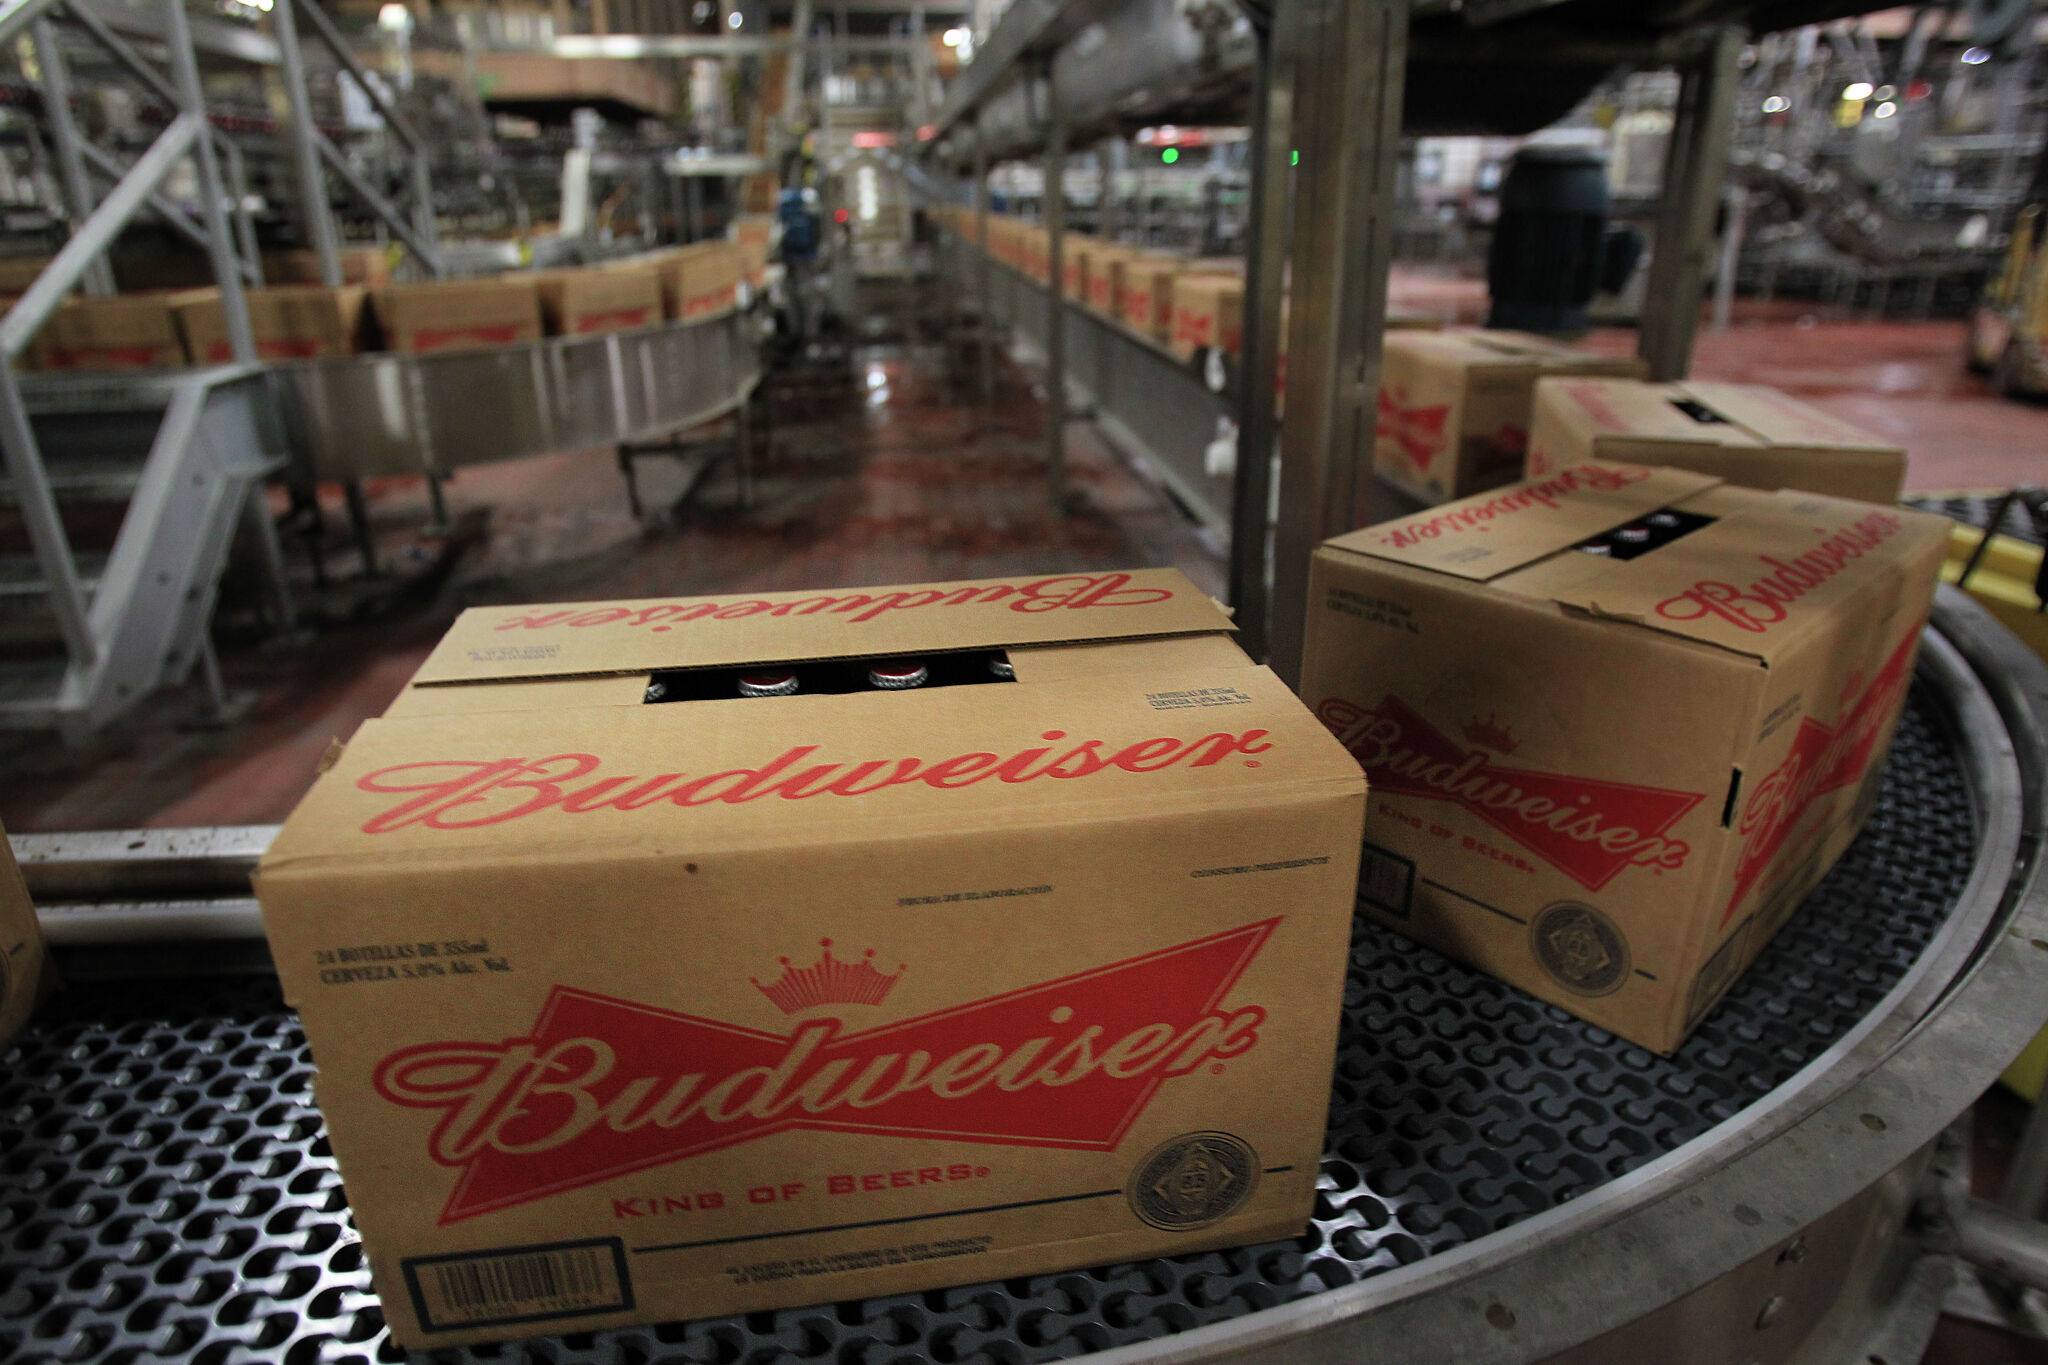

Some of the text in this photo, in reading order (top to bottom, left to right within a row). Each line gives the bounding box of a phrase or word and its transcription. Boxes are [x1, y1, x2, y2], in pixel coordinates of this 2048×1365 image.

[494, 572, 1174, 633] Budweiser
[355, 728, 1272, 834] Budweiser
[1319, 698, 1690, 878] Budweiser
[374, 1004, 1268, 1166] Budweiser
[613, 1164, 974, 1219] KING OF BEERS
